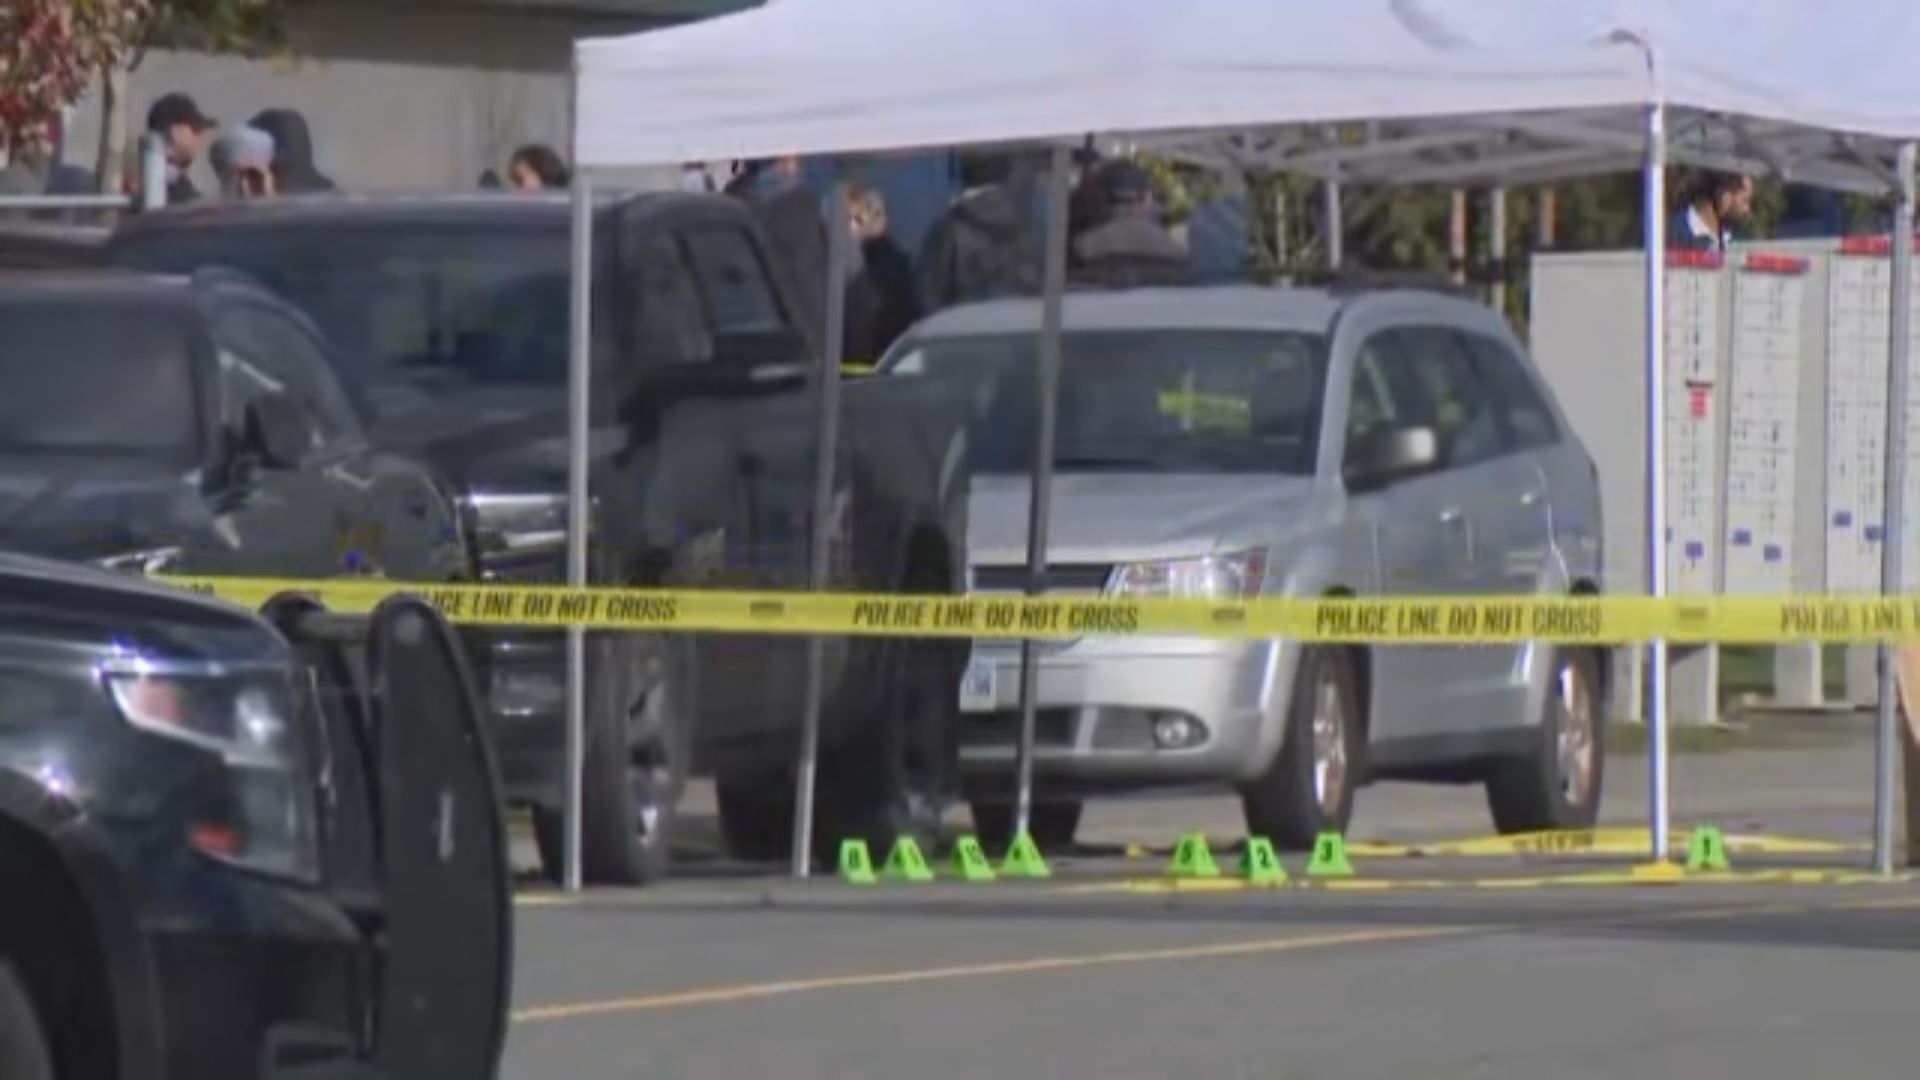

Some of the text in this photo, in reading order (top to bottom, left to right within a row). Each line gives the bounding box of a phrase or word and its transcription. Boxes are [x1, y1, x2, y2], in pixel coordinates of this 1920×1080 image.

[473, 591, 512, 618] LINE
[523, 592, 552, 619] DO
[556, 593, 599, 621] NOT
[605, 594, 677, 622] CROSS
[852, 600, 1138, 633] POLICE LINE DO NOT CROSS
[1316, 604, 1602, 636] POLICE LINE DO NOT CROSS
